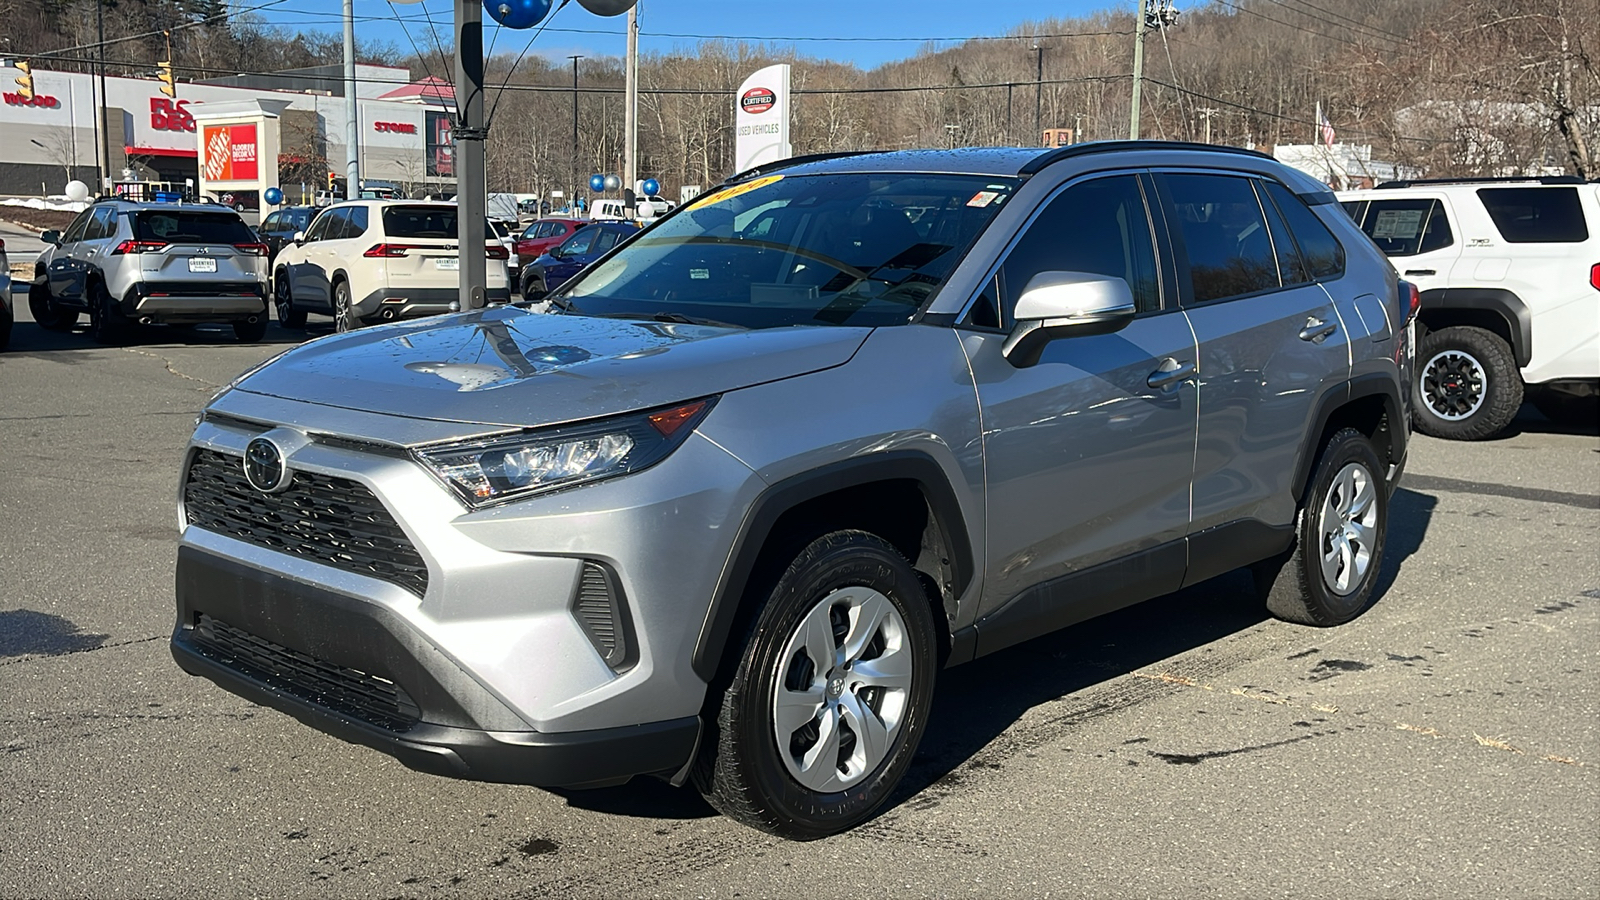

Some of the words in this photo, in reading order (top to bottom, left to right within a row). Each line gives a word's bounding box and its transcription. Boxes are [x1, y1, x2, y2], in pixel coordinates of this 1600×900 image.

[374, 121, 416, 133] STONE
[738, 126, 751, 136] USED
[752, 123, 779, 135] VEHICLES
[206, 128, 230, 180] HOME
